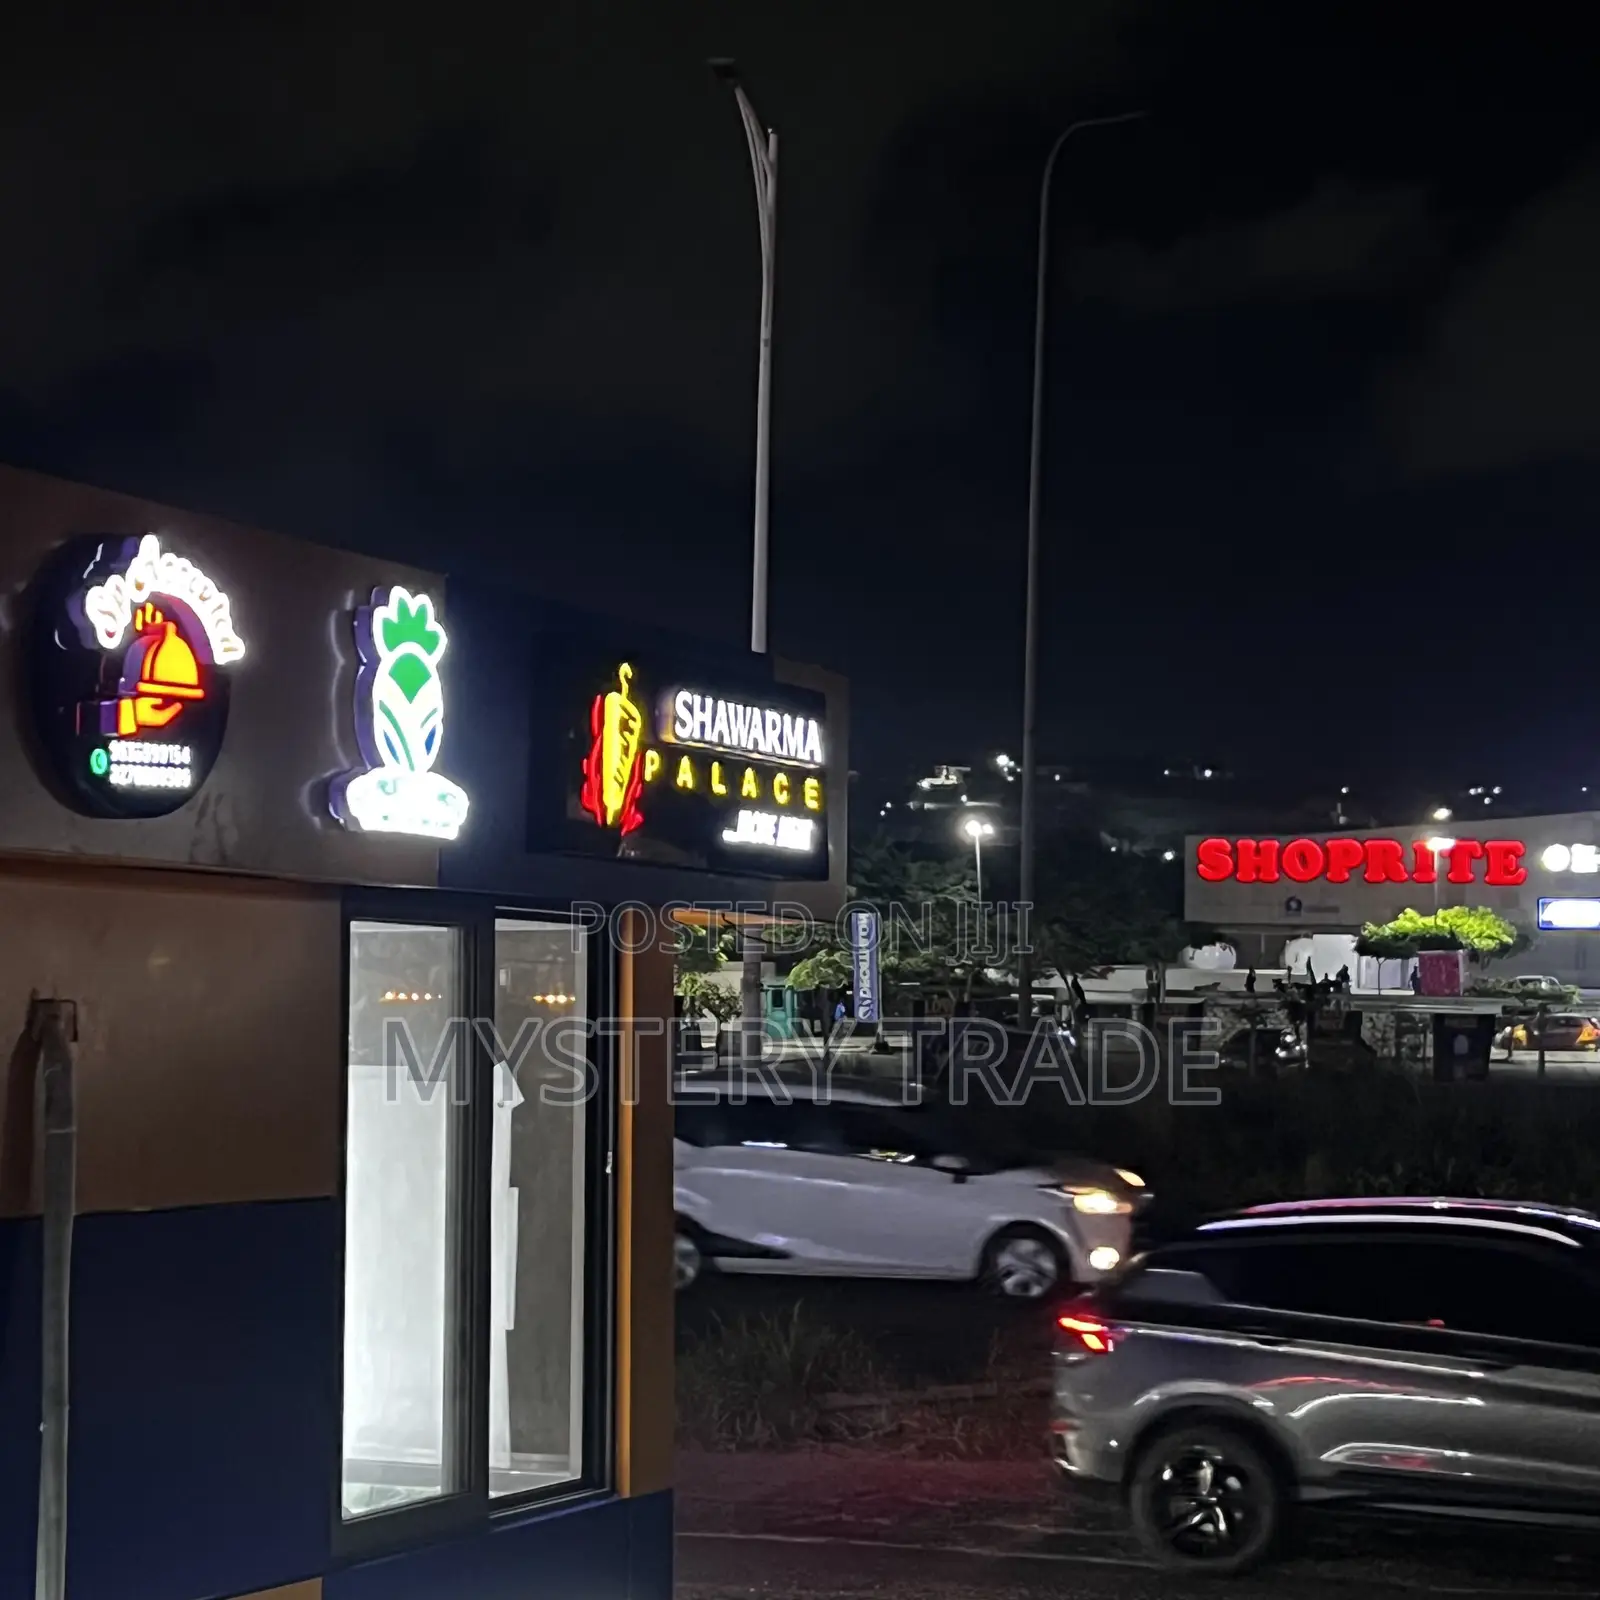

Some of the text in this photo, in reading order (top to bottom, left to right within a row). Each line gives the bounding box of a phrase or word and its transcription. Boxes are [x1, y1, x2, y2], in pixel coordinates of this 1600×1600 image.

[674, 690, 824, 763] SHAWARMA
[644, 750, 821, 810] PALACE
[1197, 837, 1528, 886] SHOPRITE
